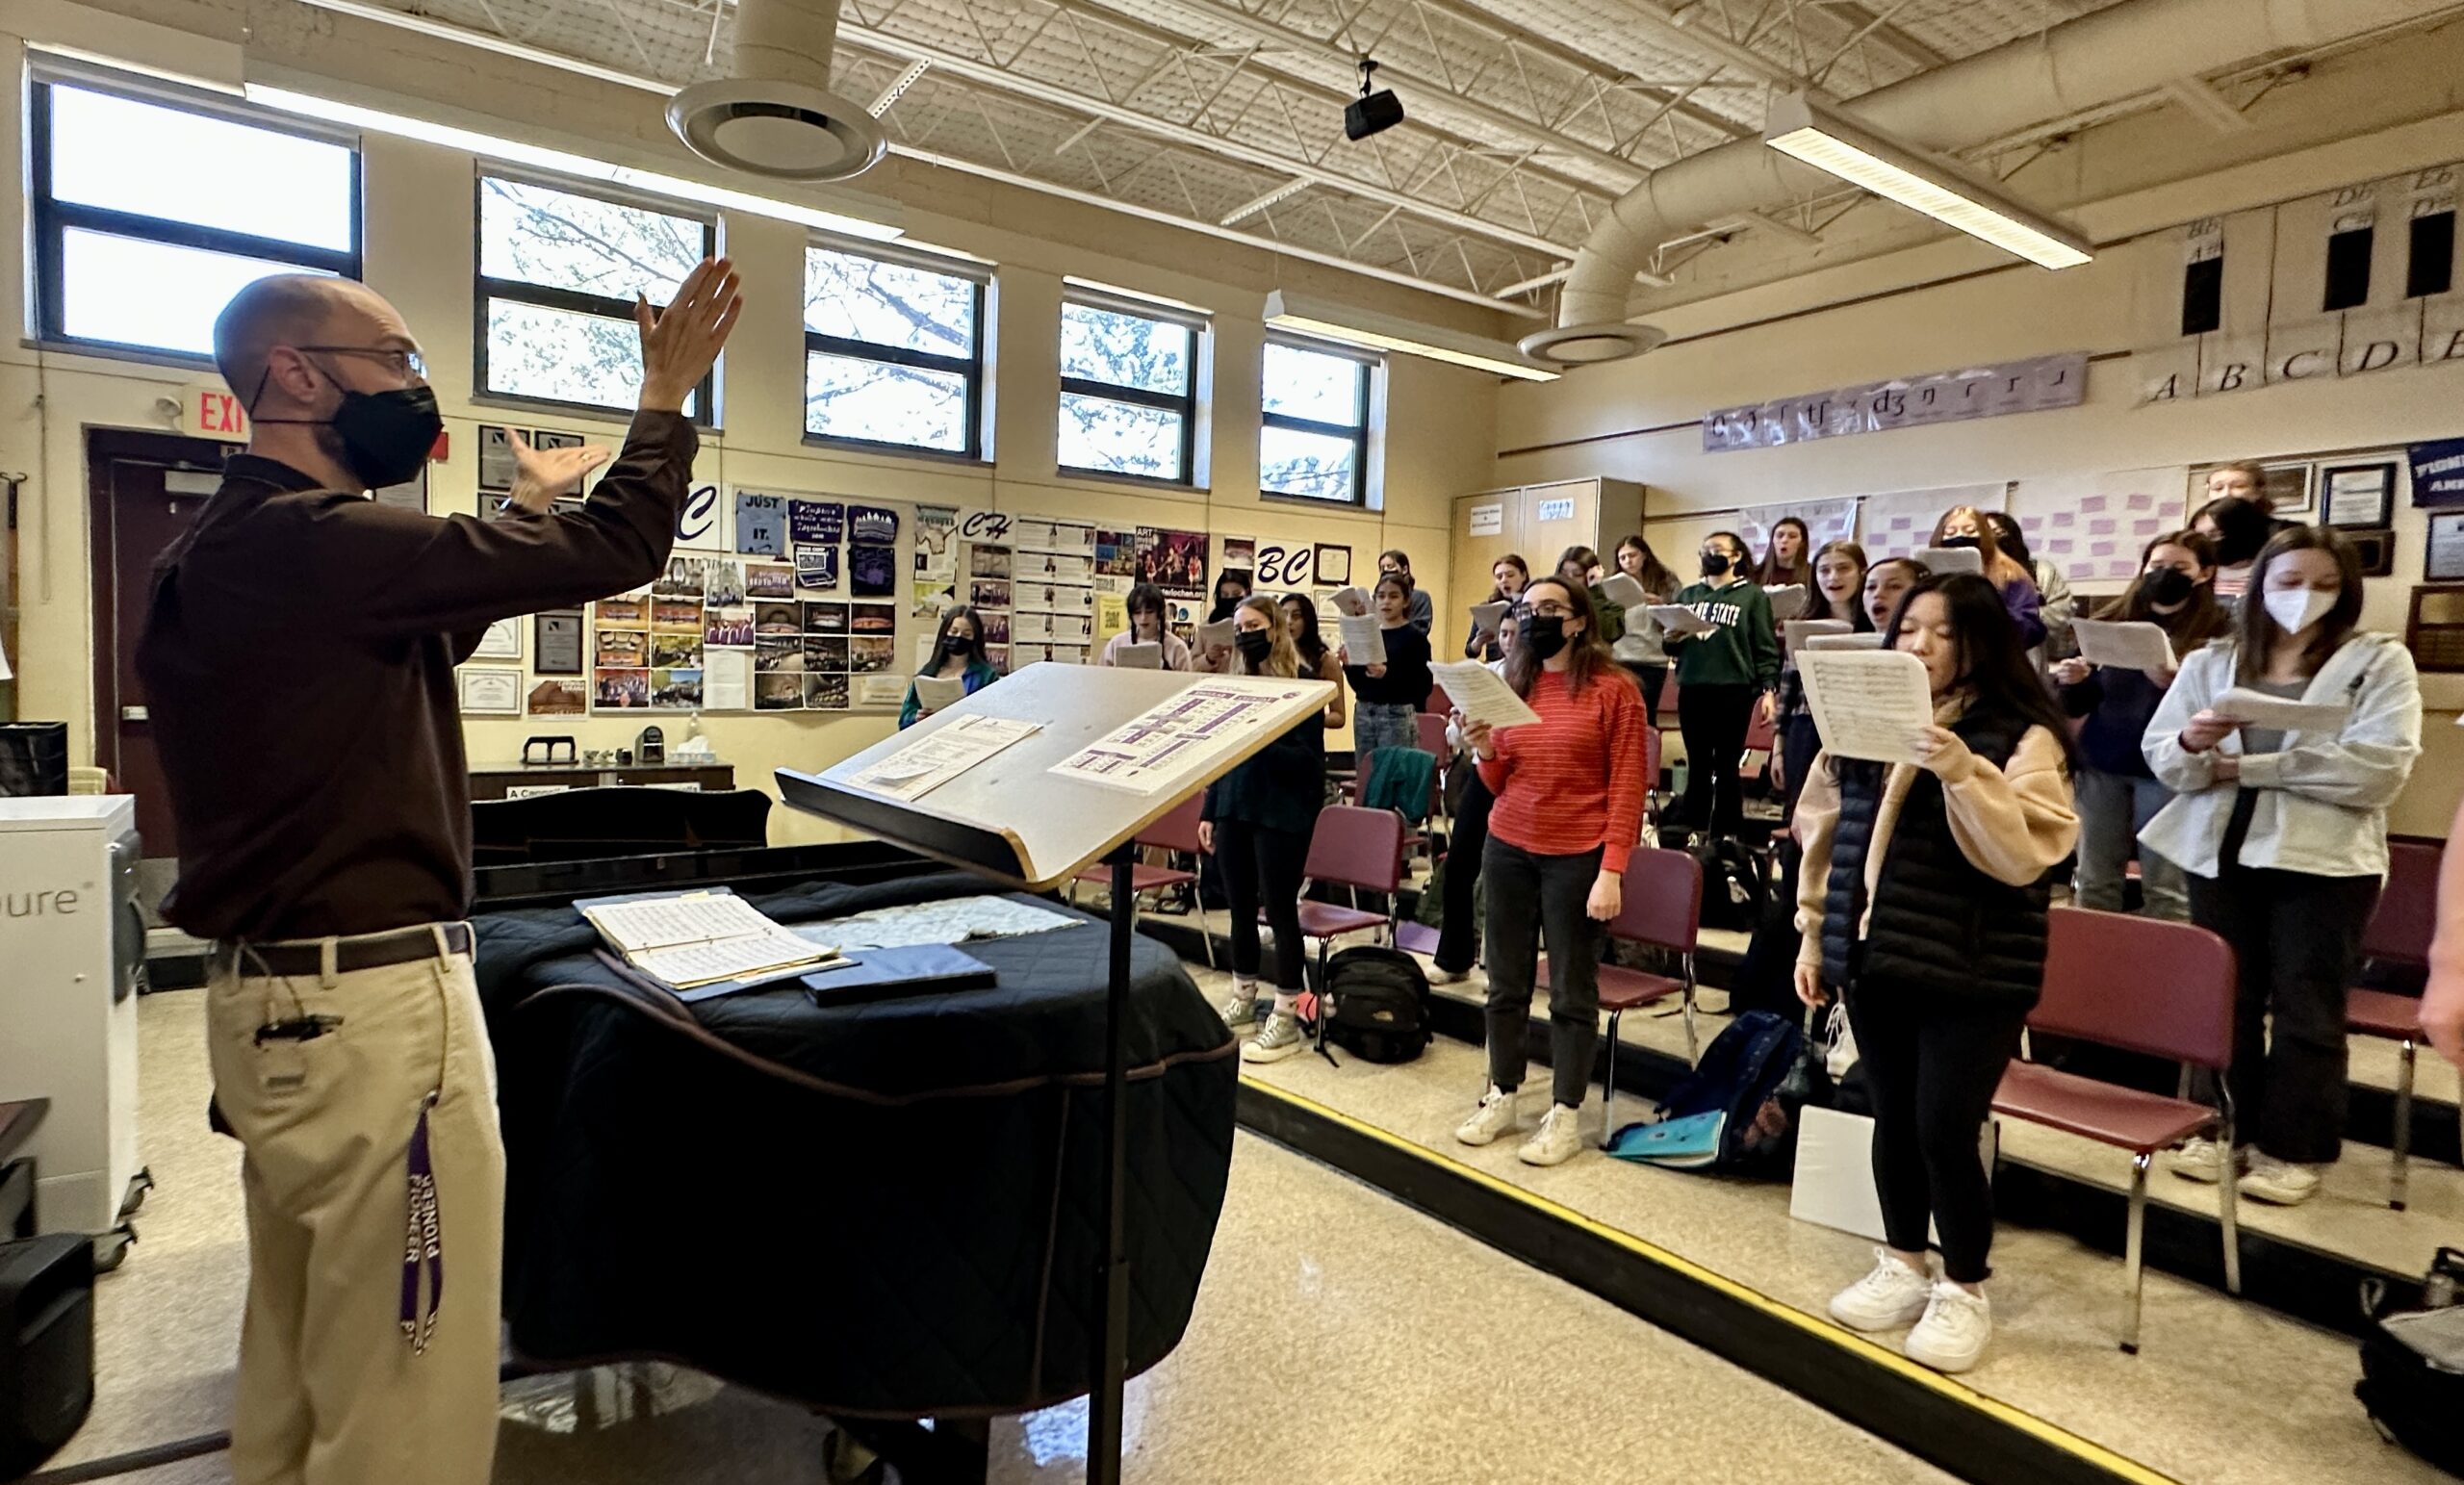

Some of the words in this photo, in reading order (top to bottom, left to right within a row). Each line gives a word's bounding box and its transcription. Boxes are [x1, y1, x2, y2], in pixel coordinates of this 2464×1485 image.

[2150, 373, 2176, 400] A
[2220, 363, 2247, 392] B
[2283, 349, 2321, 379] C
[2357, 341, 2399, 371] D
[200, 392, 243, 433] EXI
[675, 485, 717, 541] C
[745, 496, 781, 509] JUST
[1137, 527, 1153, 537] ART
[1257, 546, 1311, 586] BC
[1161, 588, 1207, 602] terlochen.org
[1710, 602, 1740, 627] STATE
[0, 890, 78, 918] ure
[405, 1174, 423, 1263] PIONEER
[422, 1174, 440, 1259] PIONEER
